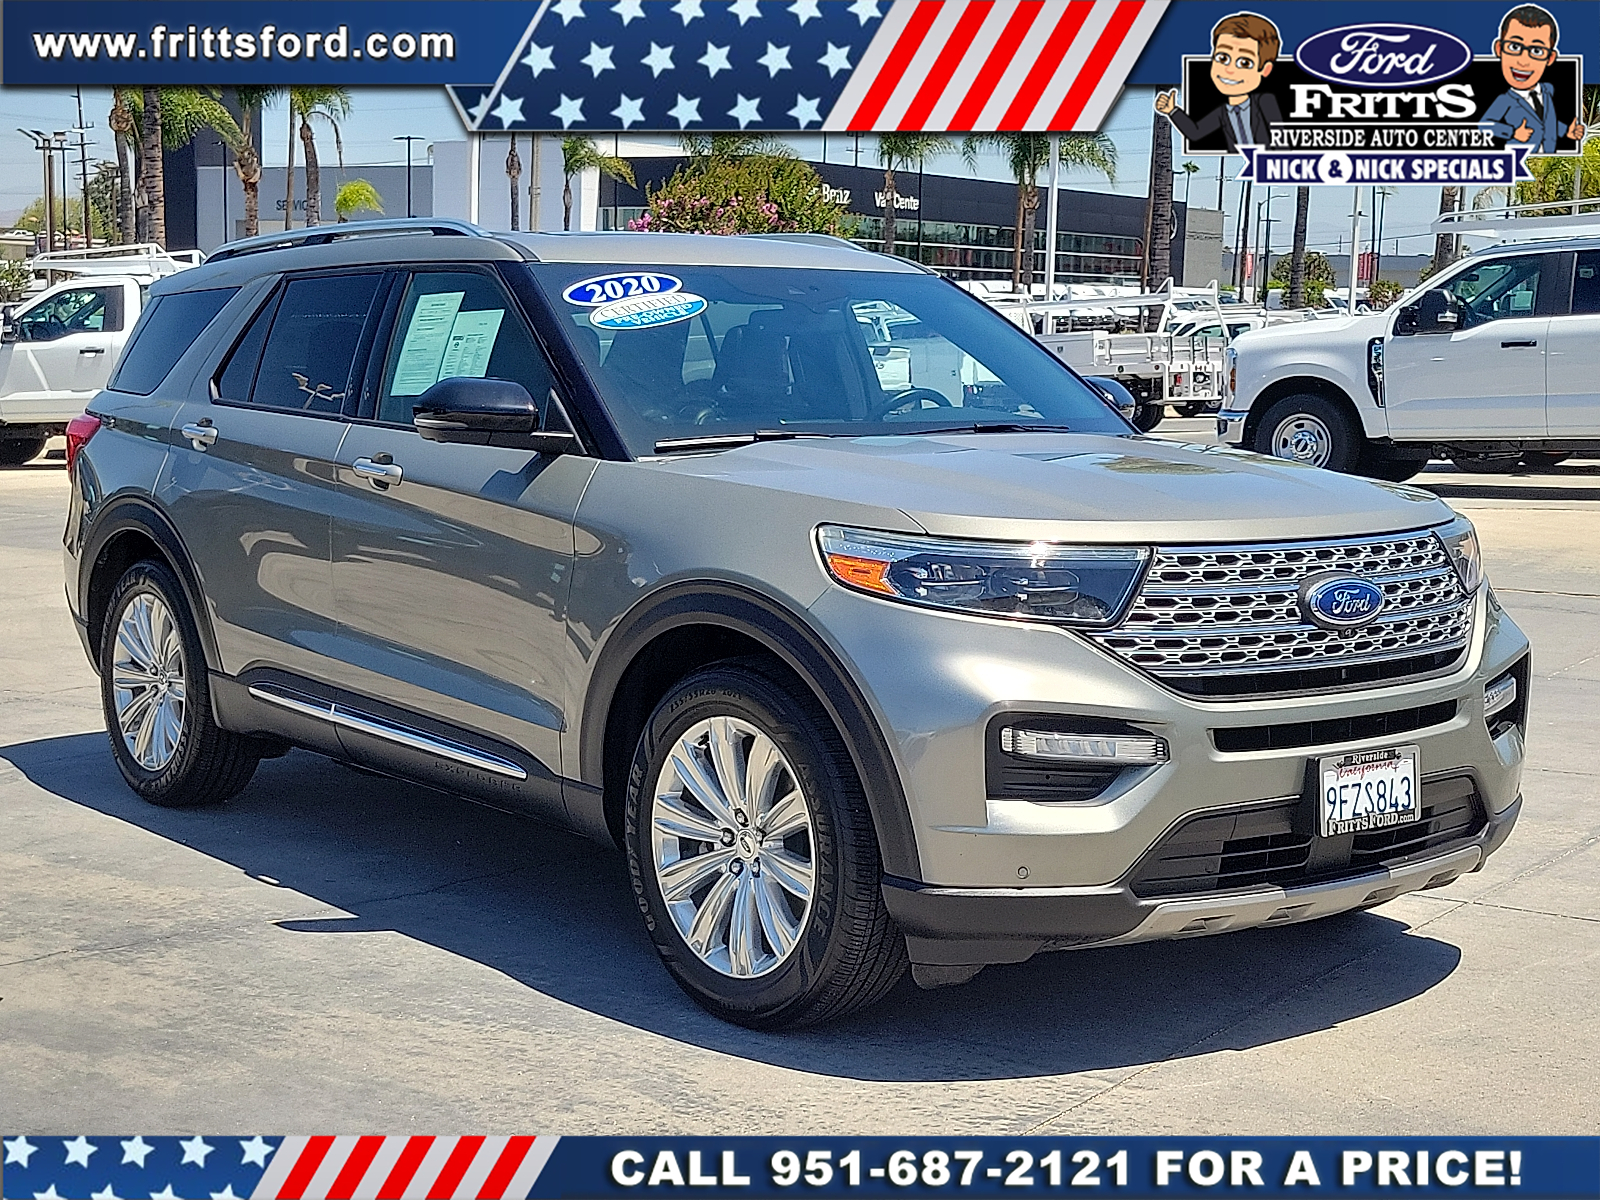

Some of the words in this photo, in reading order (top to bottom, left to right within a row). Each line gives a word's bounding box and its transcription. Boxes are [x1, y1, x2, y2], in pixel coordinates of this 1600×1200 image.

[585, 275, 661, 302] 2020
[600, 294, 687, 318] CERTIFIED
[1332, 588, 1372, 614] Ford
[1352, 752, 1388, 765] Riverside
[1326, 776, 1412, 820] 9FZS843
[627, 763, 656, 932] GOODYEAR
